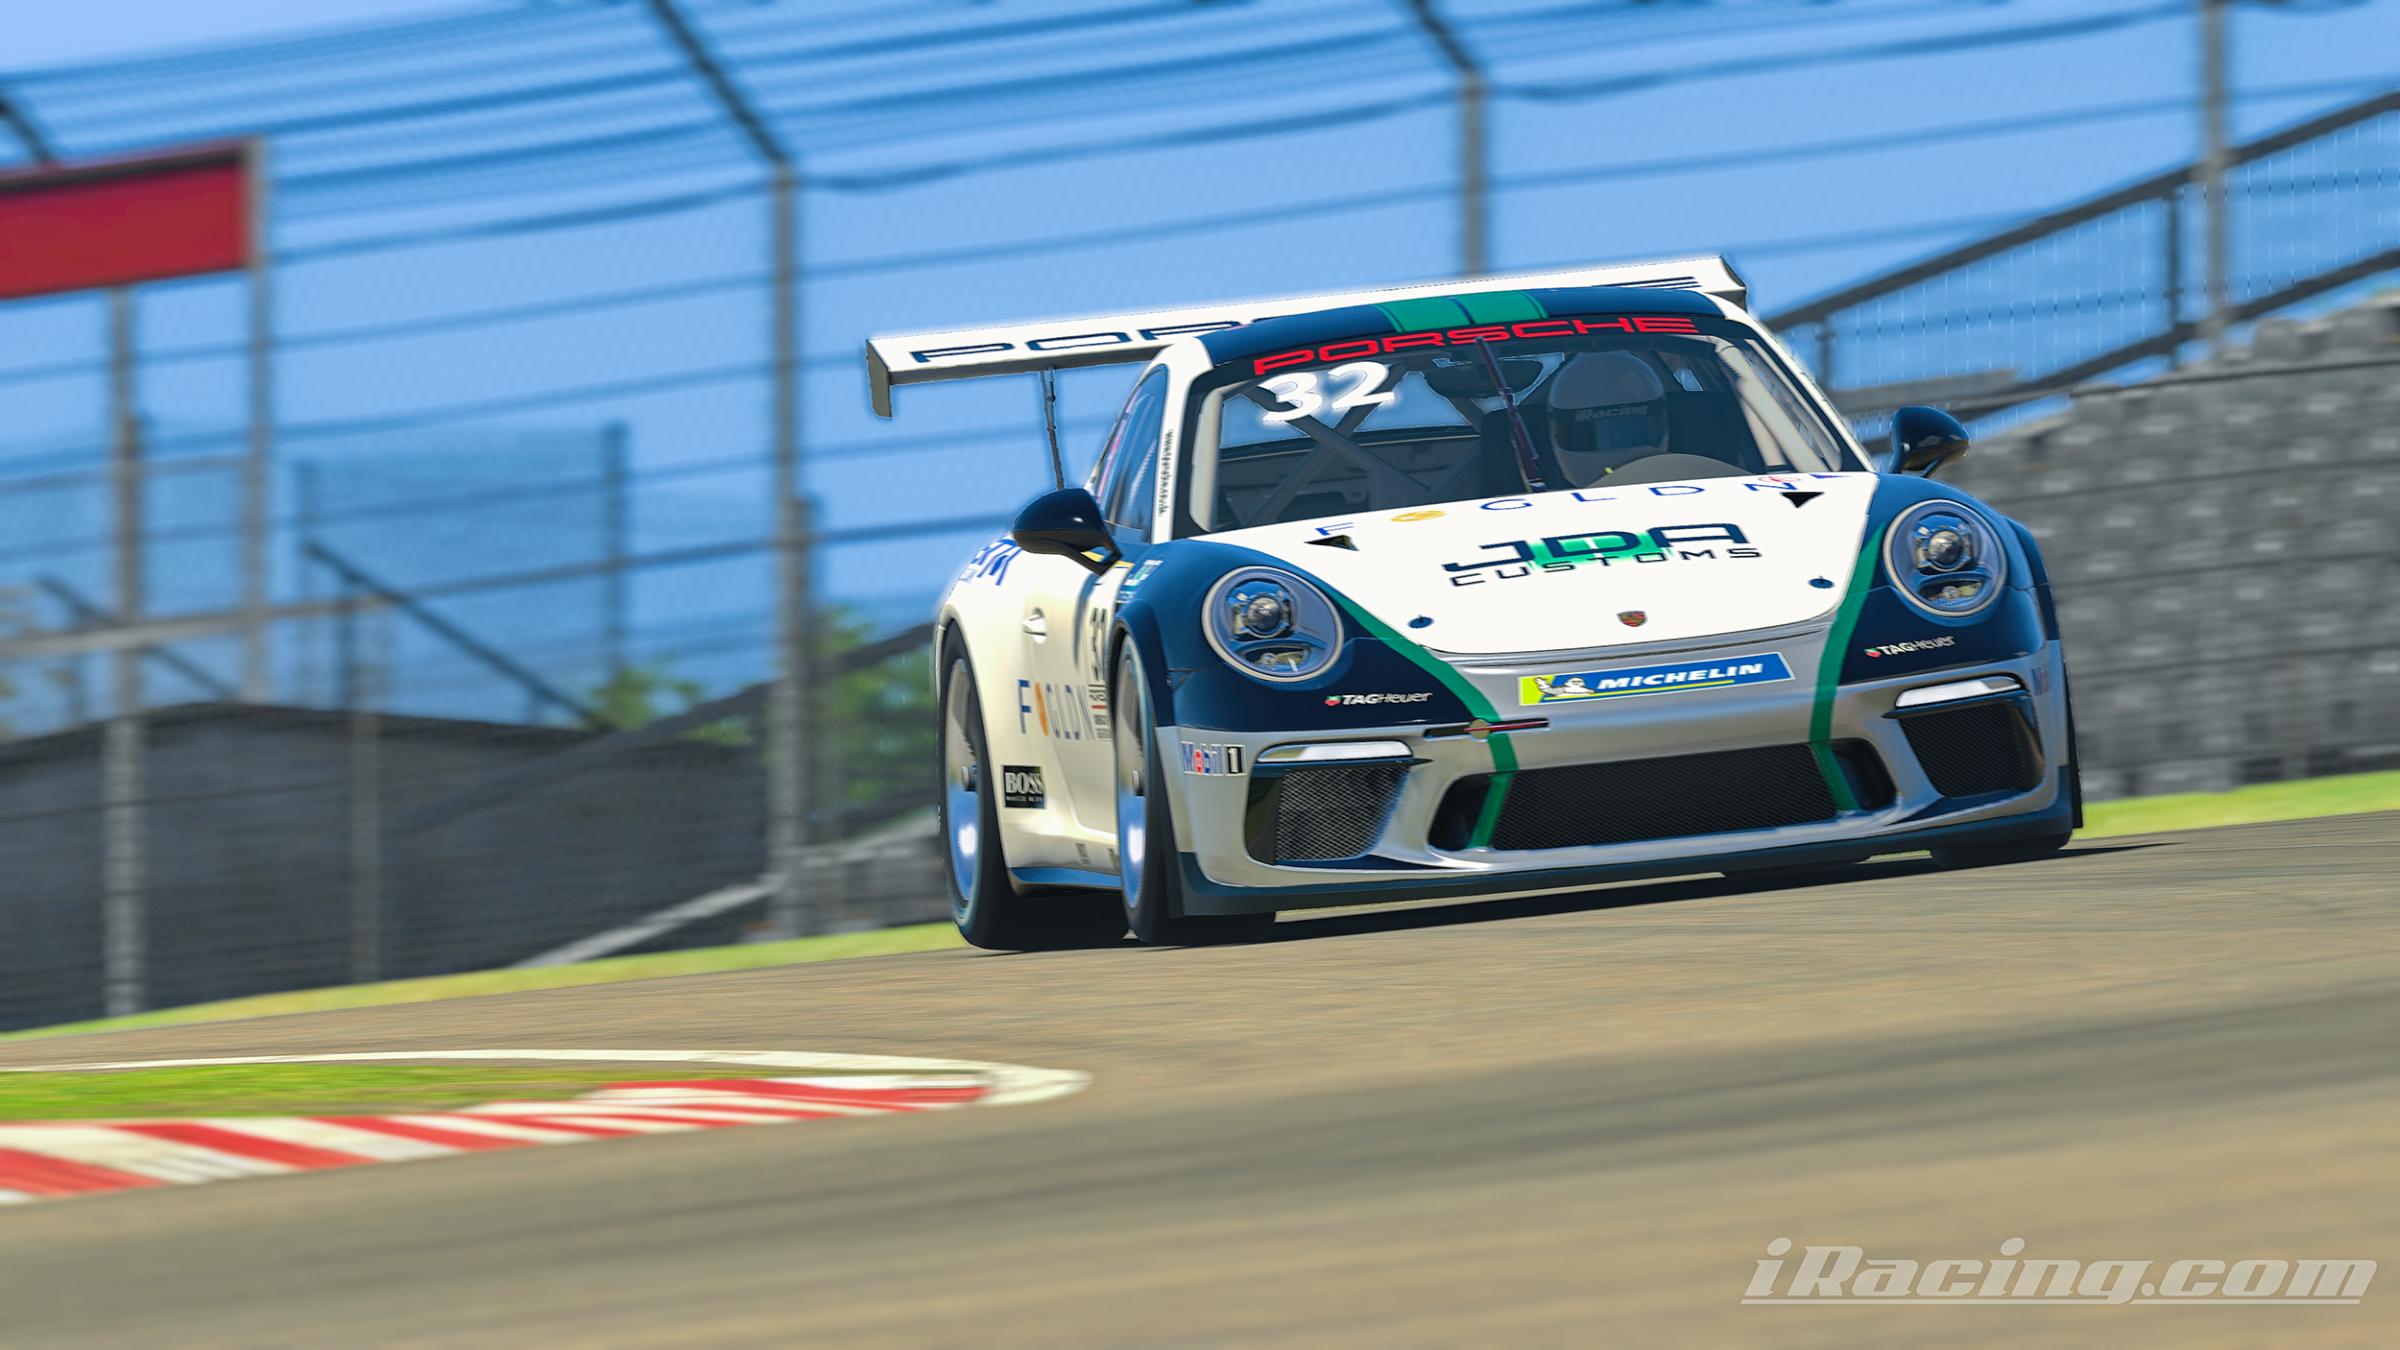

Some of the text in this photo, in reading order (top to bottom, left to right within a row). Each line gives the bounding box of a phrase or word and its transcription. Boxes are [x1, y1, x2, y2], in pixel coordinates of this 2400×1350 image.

[1253, 317, 1698, 376] PORSCHE
[1260, 361, 1395, 422] 32
[1442, 523, 1749, 572] JDA
[1450, 547, 1762, 587] CUSTOMS
[1597, 663, 1763, 690] MICHELIN
[1004, 772, 1043, 794] BOSS
